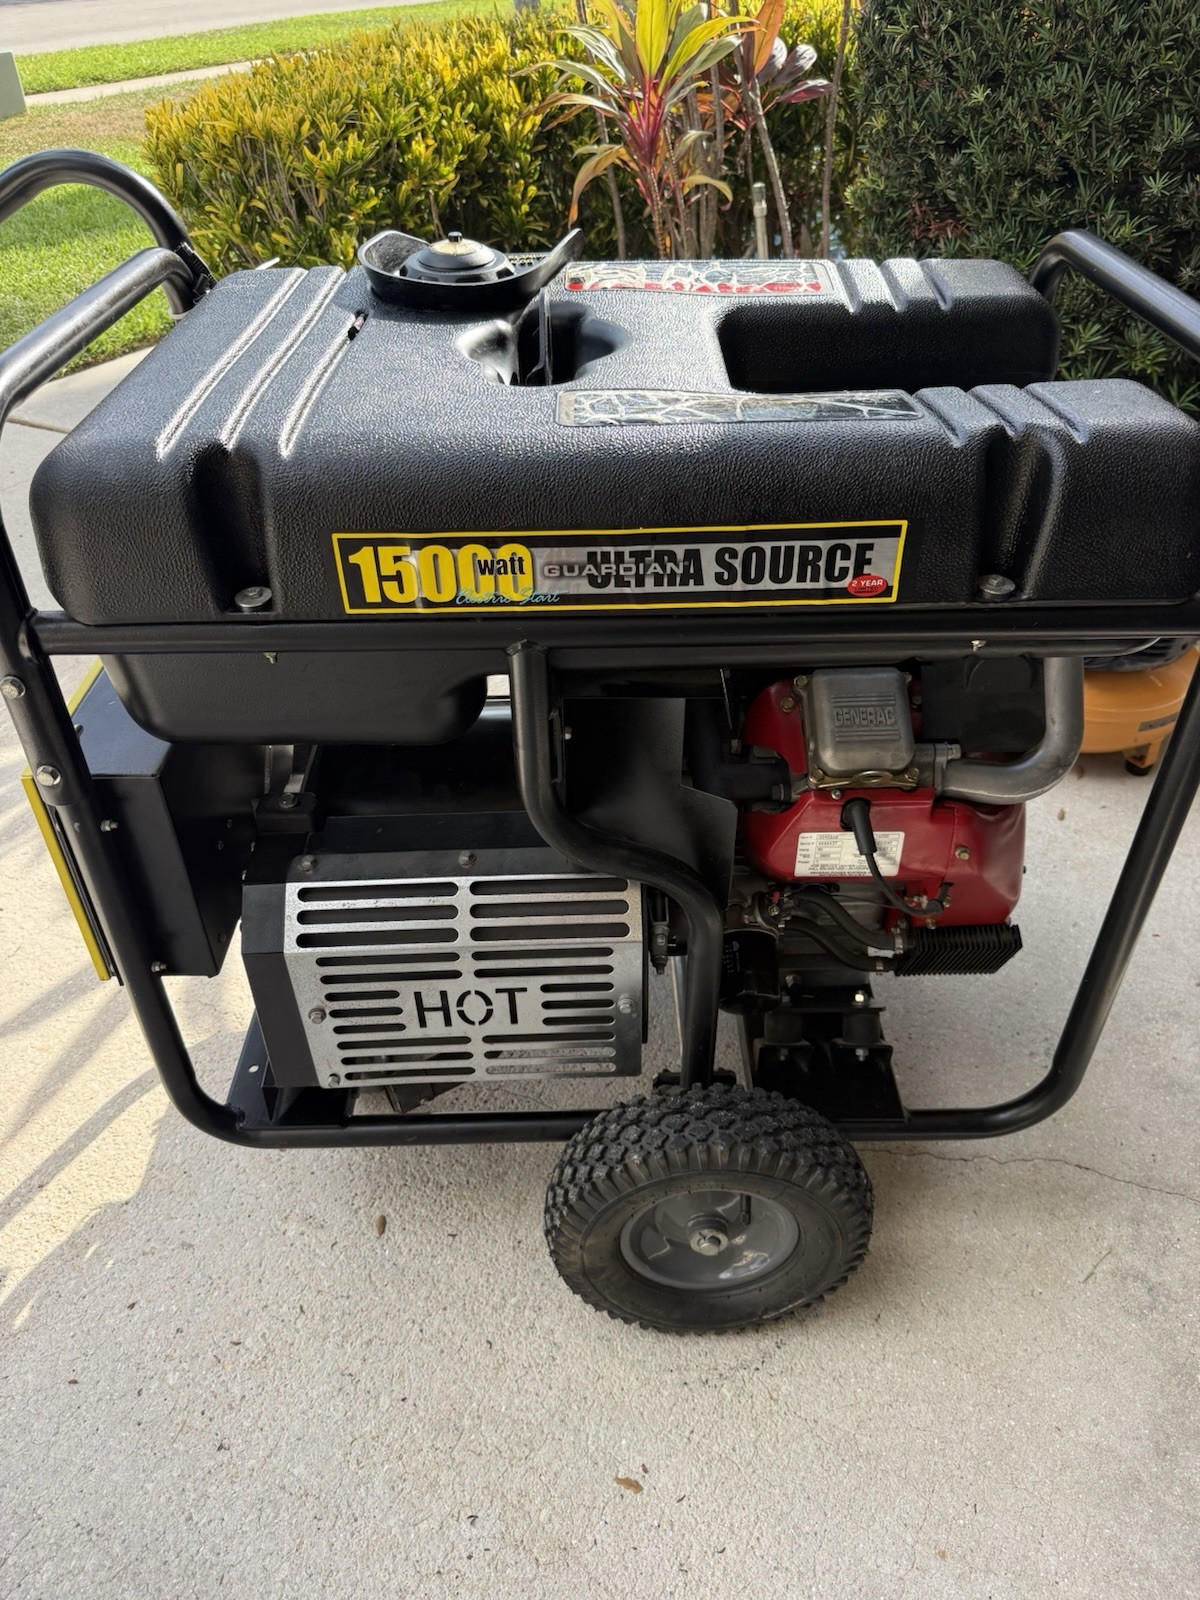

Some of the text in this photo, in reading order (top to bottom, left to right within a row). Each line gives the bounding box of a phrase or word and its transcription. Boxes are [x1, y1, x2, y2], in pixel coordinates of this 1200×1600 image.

[348, 543, 534, 604] 15000
[477, 556, 526, 575] watt
[543, 562, 685, 577] GUARDIAN
[587, 549, 704, 589] ULTRA
[714, 543, 875, 586] SOURCE
[860, 579, 884, 587] YEAR
[519, 586, 568, 606] Start
[834, 706, 896, 727] GENERAC
[414, 987, 528, 1028] HOT
